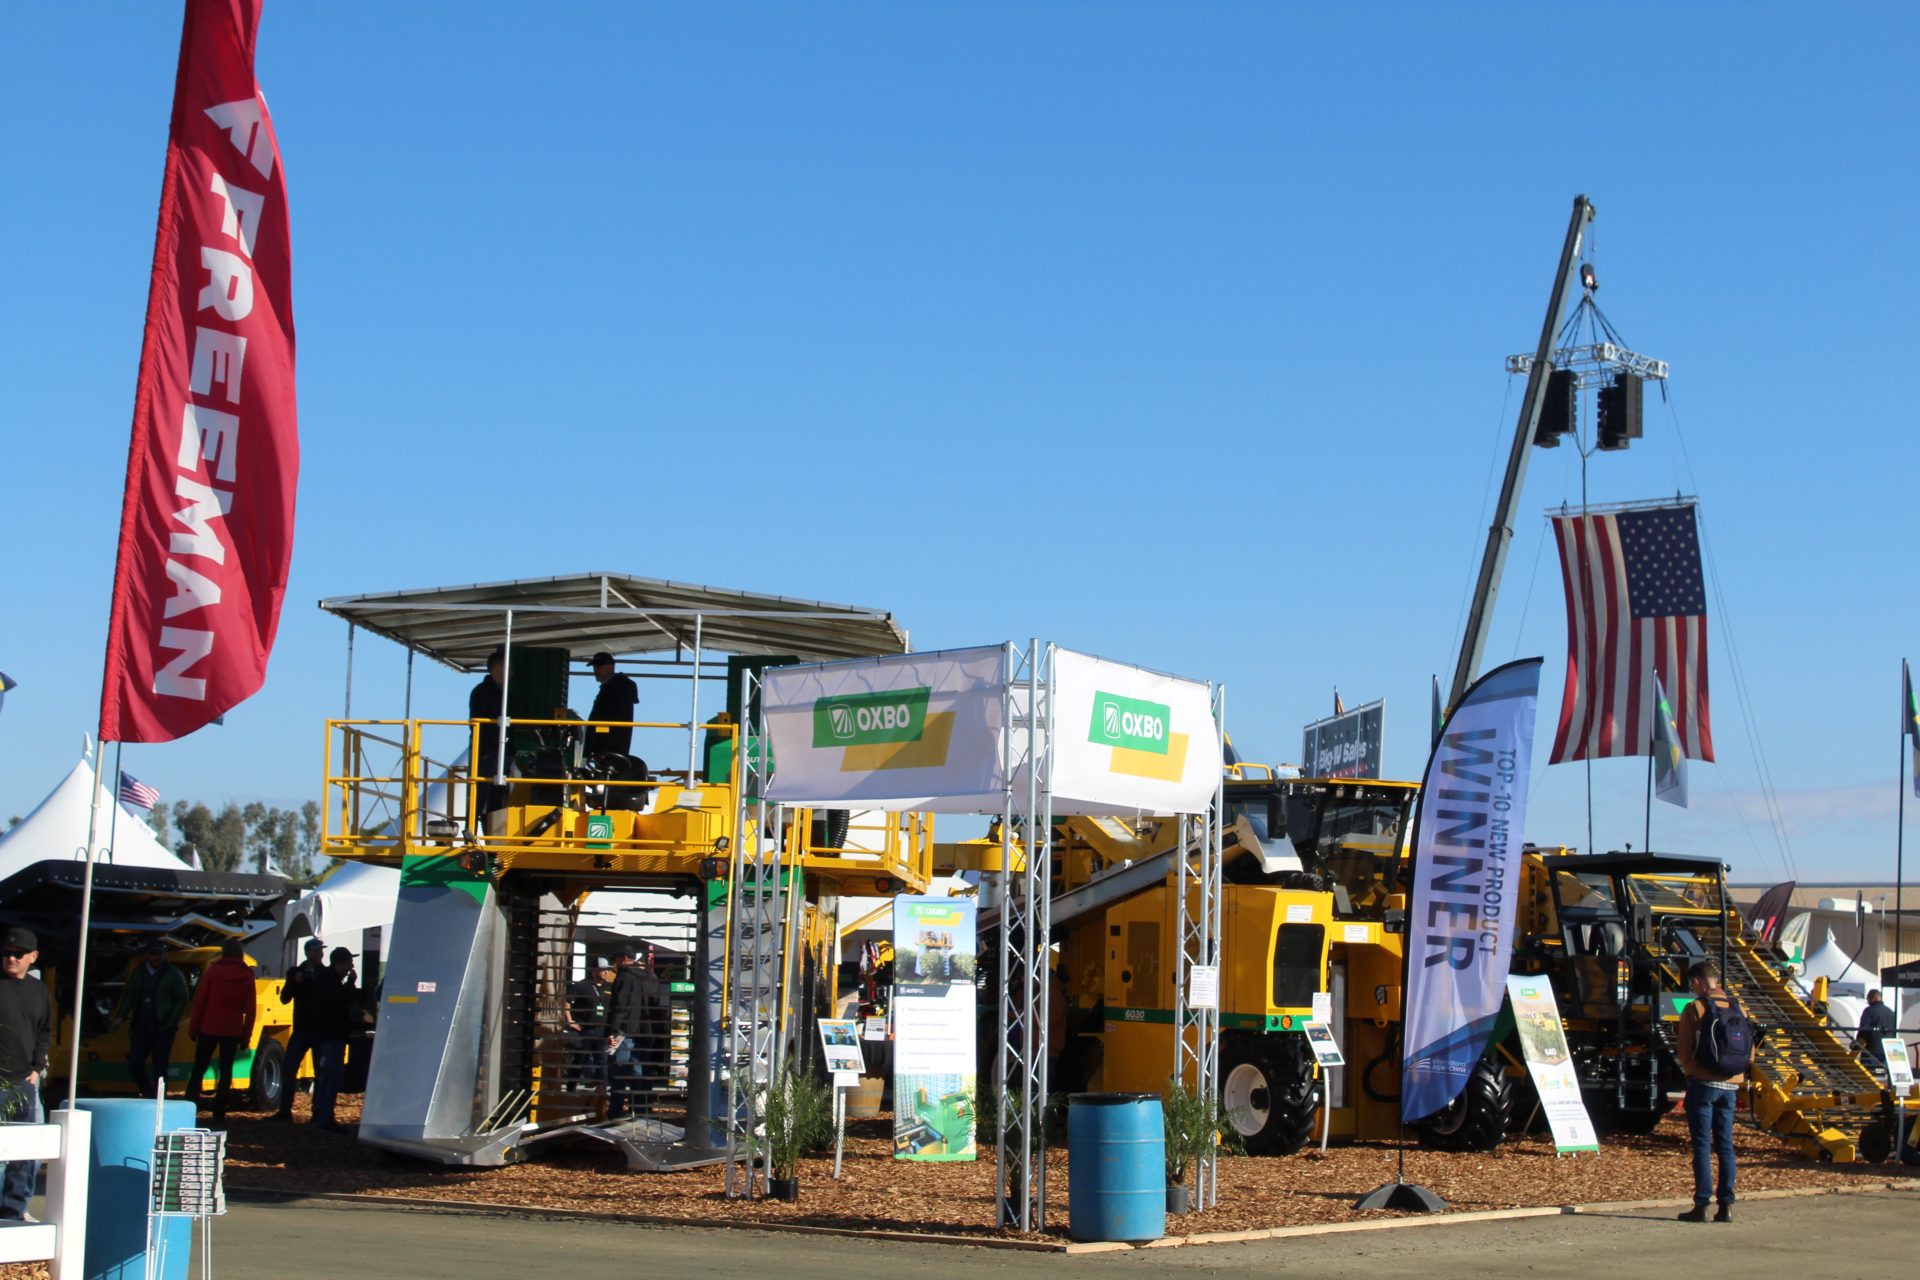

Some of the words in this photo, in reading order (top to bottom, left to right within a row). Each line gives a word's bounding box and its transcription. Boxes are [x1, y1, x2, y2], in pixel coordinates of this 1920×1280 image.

[152, 172, 265, 701] FREEMAN
[856, 703, 910, 732] OXBO
[1121, 711, 1164, 741] OXBO
[1424, 728, 1497, 971] WINNER
[1489, 818, 1510, 861] NEW
[1478, 867, 1505, 956] PRODUCT
